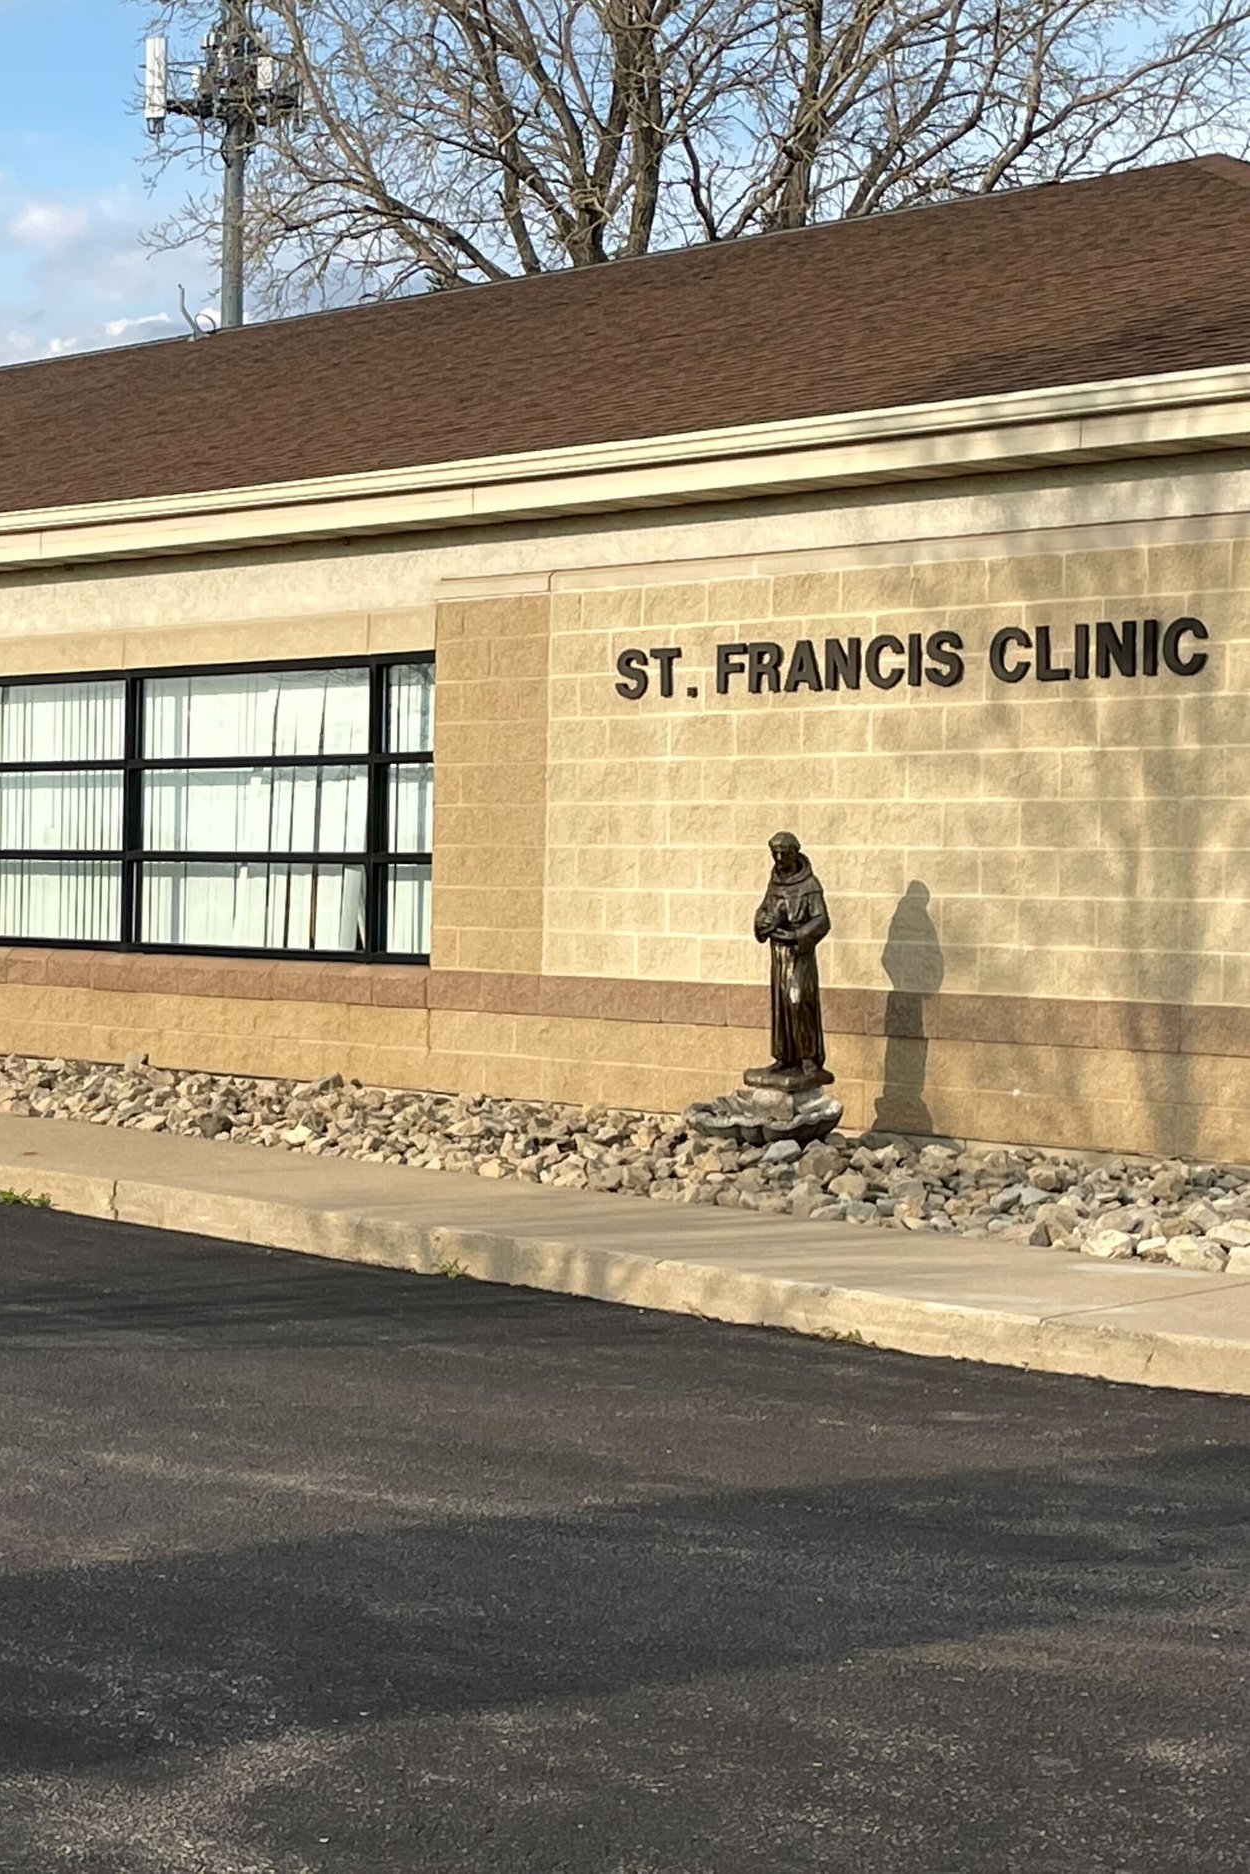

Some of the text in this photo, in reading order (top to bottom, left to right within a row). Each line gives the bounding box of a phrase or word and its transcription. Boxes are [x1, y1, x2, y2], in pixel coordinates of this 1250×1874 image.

[615, 617, 1209, 700] ST. FRANCIS CLINIC
